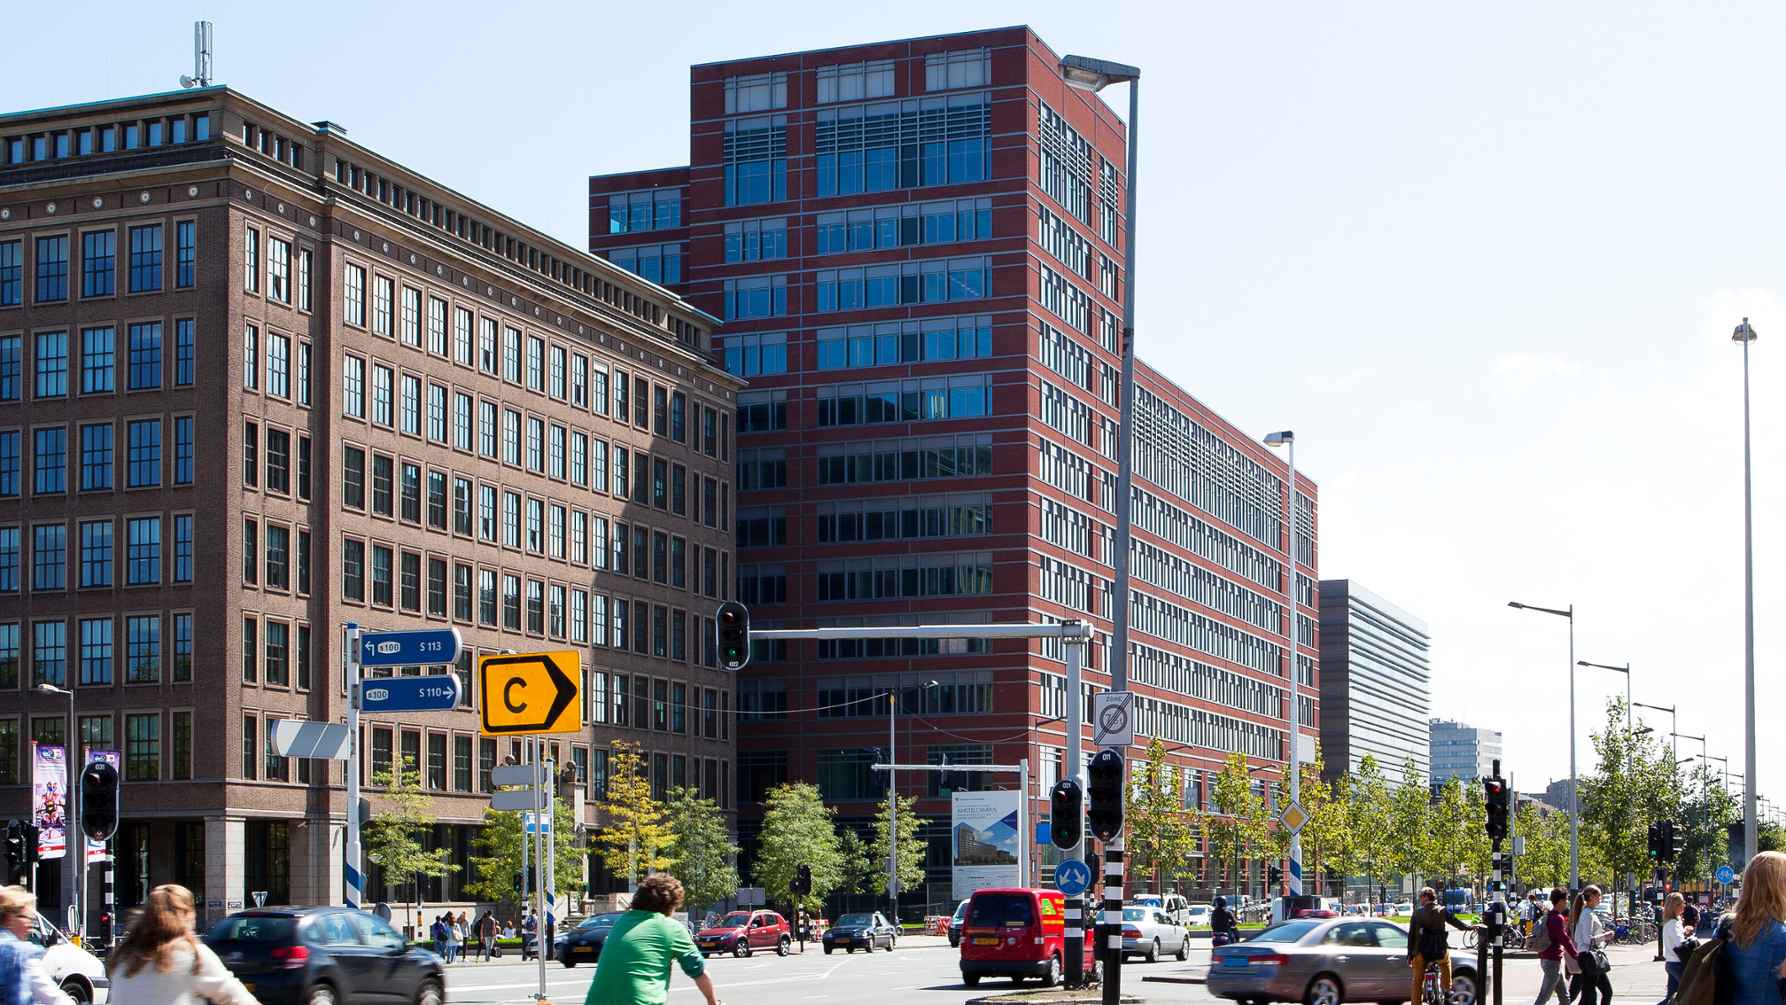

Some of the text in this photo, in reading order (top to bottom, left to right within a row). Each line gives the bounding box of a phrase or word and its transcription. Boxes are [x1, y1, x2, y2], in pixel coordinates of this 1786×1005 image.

[419, 641, 426, 652] S
[428, 641, 442, 652] 113
[419, 688, 425, 698] S
[427, 688, 441, 697] 110
[503, 676, 528, 714] C
